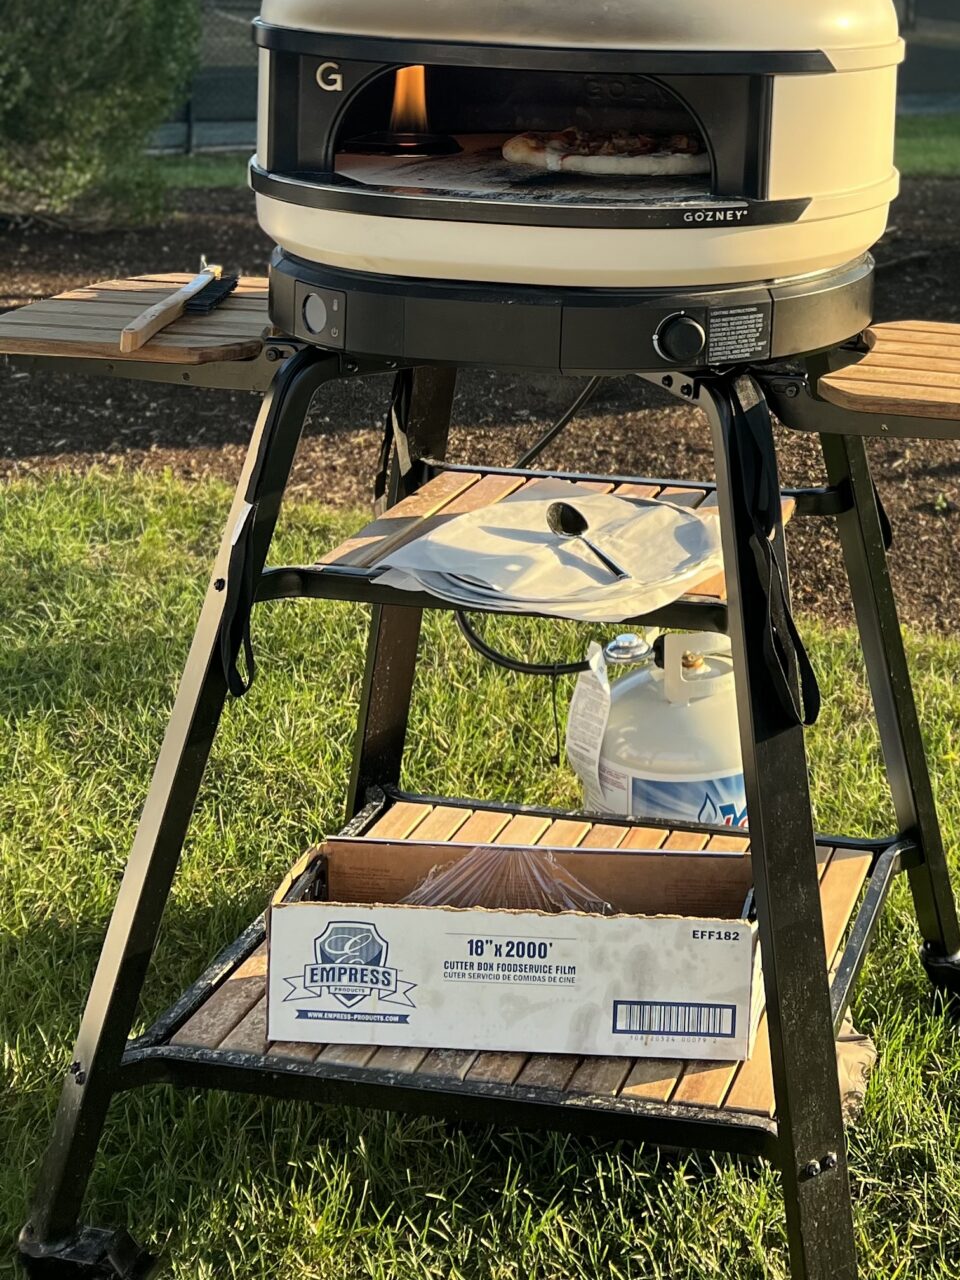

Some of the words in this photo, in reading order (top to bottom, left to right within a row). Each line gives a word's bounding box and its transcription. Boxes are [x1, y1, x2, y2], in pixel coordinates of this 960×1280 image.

[316, 61, 342, 92] G
[683, 210, 742, 221] GOZNEY
[692, 929, 740, 941] EFF182
[505, 941, 553, 959] 2000'
[444, 961, 474, 971] CUTTER
[477, 962, 494, 972] BOX
[496, 962, 553, 974] FOODSERVICE
[556, 965, 576, 975] FILM
[310, 966, 392, 987] EMPRESS
[468, 972, 500, 980] SERVICIO
[513, 974, 546, 983] COMIDAS
[559, 976, 576, 984] CINE
[307, 1011, 399, 1022] WWW.EMPRESS-PRODUCTS.COM
